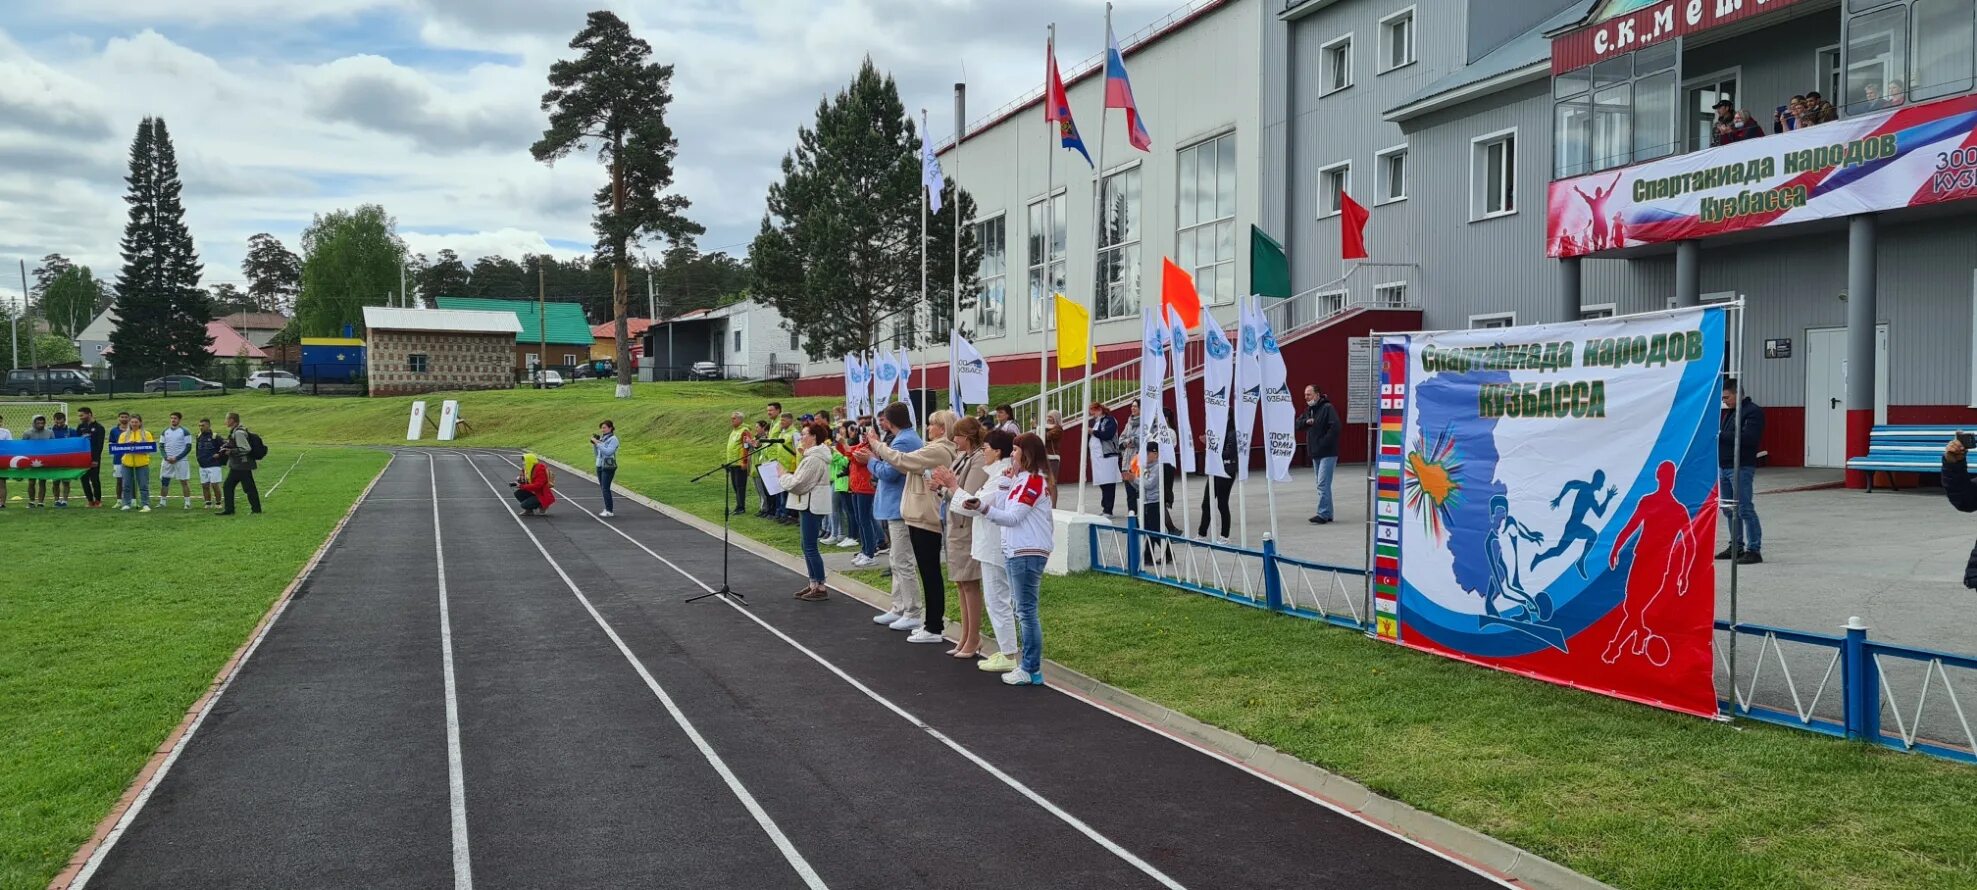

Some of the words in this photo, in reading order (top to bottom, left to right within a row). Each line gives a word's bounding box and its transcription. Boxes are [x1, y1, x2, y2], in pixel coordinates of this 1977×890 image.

[1632, 155, 1775, 203] Спартакиада
[1783, 132, 1899, 175] народов
[1699, 184, 1807, 224] Кузбасса
[1421, 340, 1575, 374] Спартакиада
[1583, 330, 1704, 368] народов
[1478, 380, 1606, 419] КУЗБАССА
